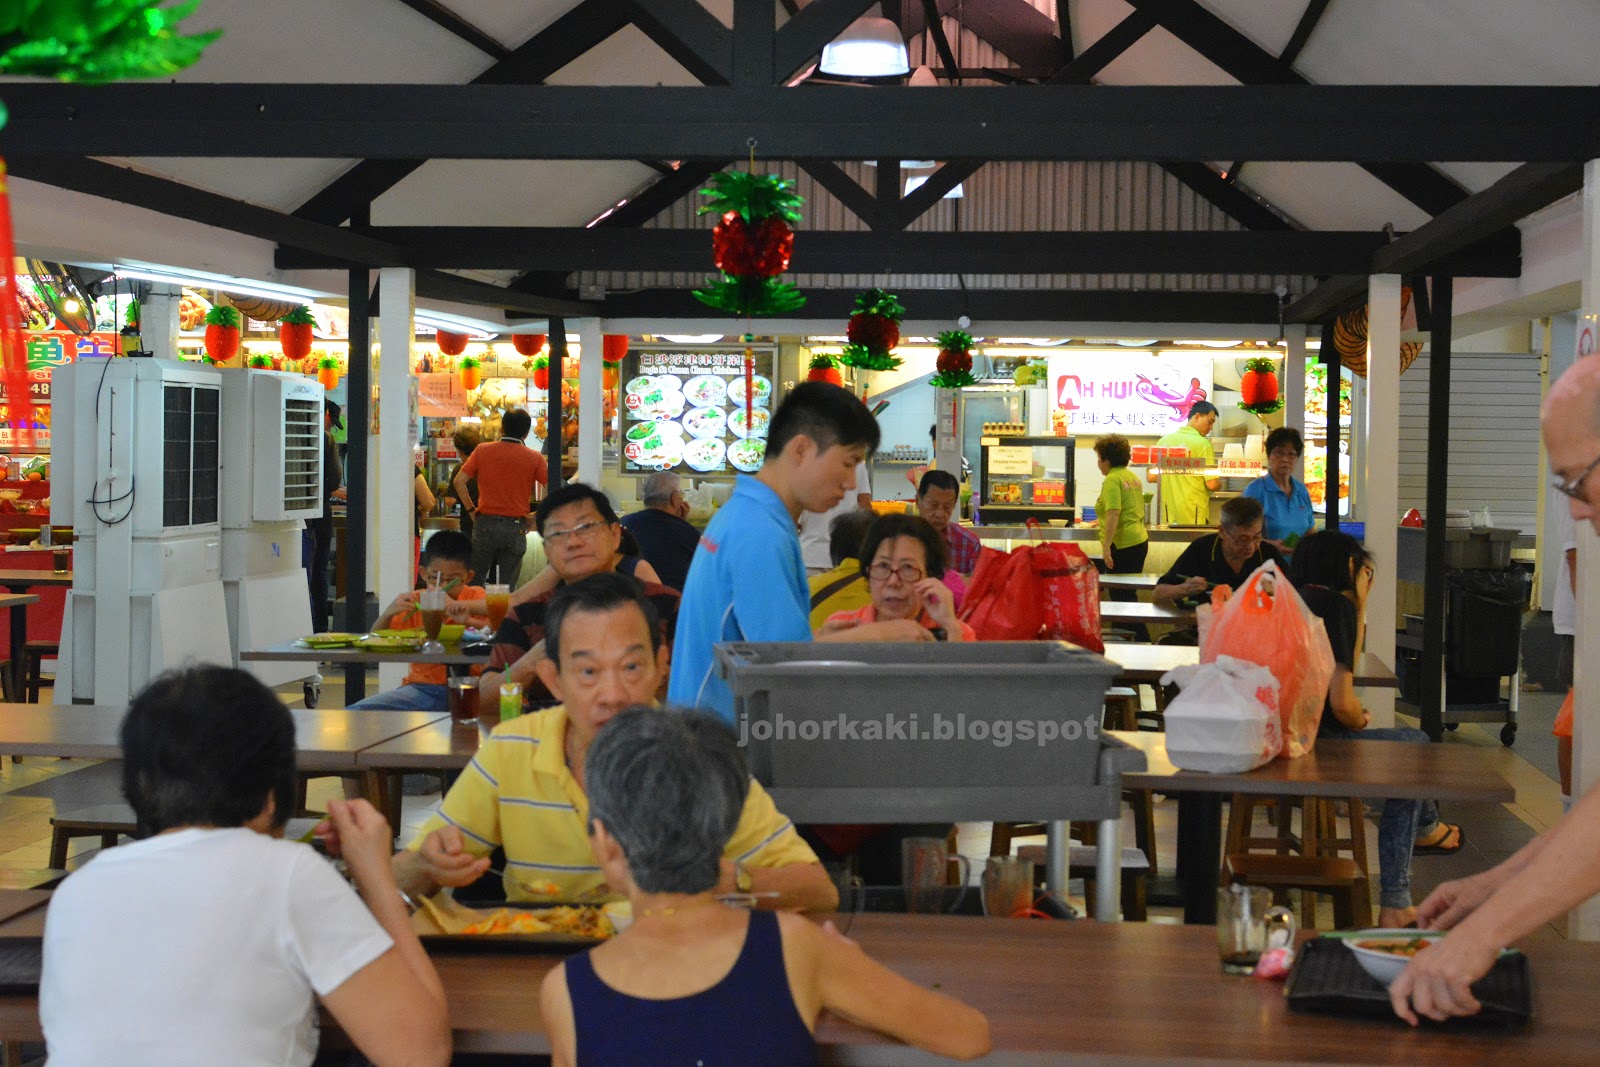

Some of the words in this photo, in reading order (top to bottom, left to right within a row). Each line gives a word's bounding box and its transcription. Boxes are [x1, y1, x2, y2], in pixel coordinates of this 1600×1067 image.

[740, 365, 756, 374] Re
[783, 381, 795, 390] 13
[1057, 375, 1094, 410] AH
[1102, 381, 1133, 399] HUI
